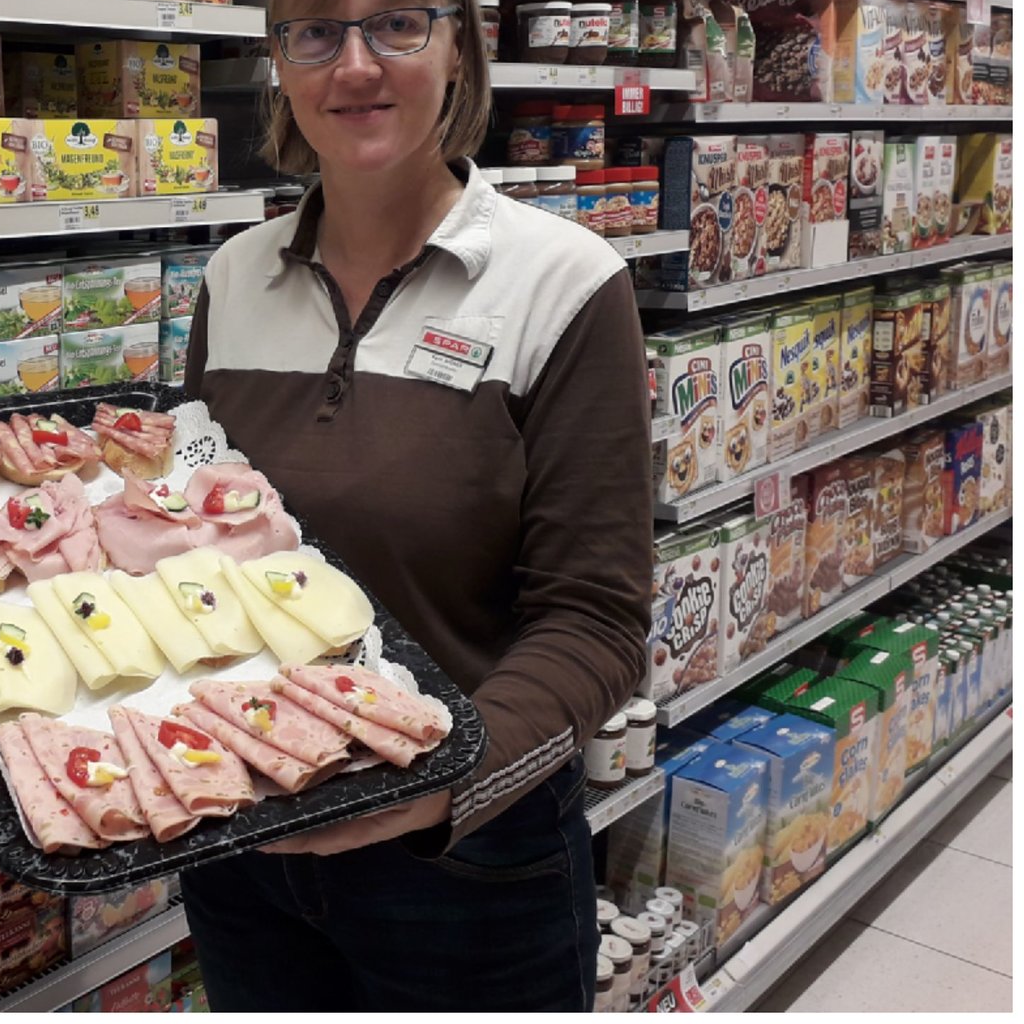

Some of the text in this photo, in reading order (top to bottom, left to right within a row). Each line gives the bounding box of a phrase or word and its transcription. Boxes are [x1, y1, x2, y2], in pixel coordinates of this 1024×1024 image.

[578, 18, 608, 28] nutella
[32, 140, 48, 150] BIO
[433, 335, 472, 354] SPAR
[691, 359, 709, 372] CINI
[850, 706, 865, 727] S
[657, 991, 677, 1012] NEU
